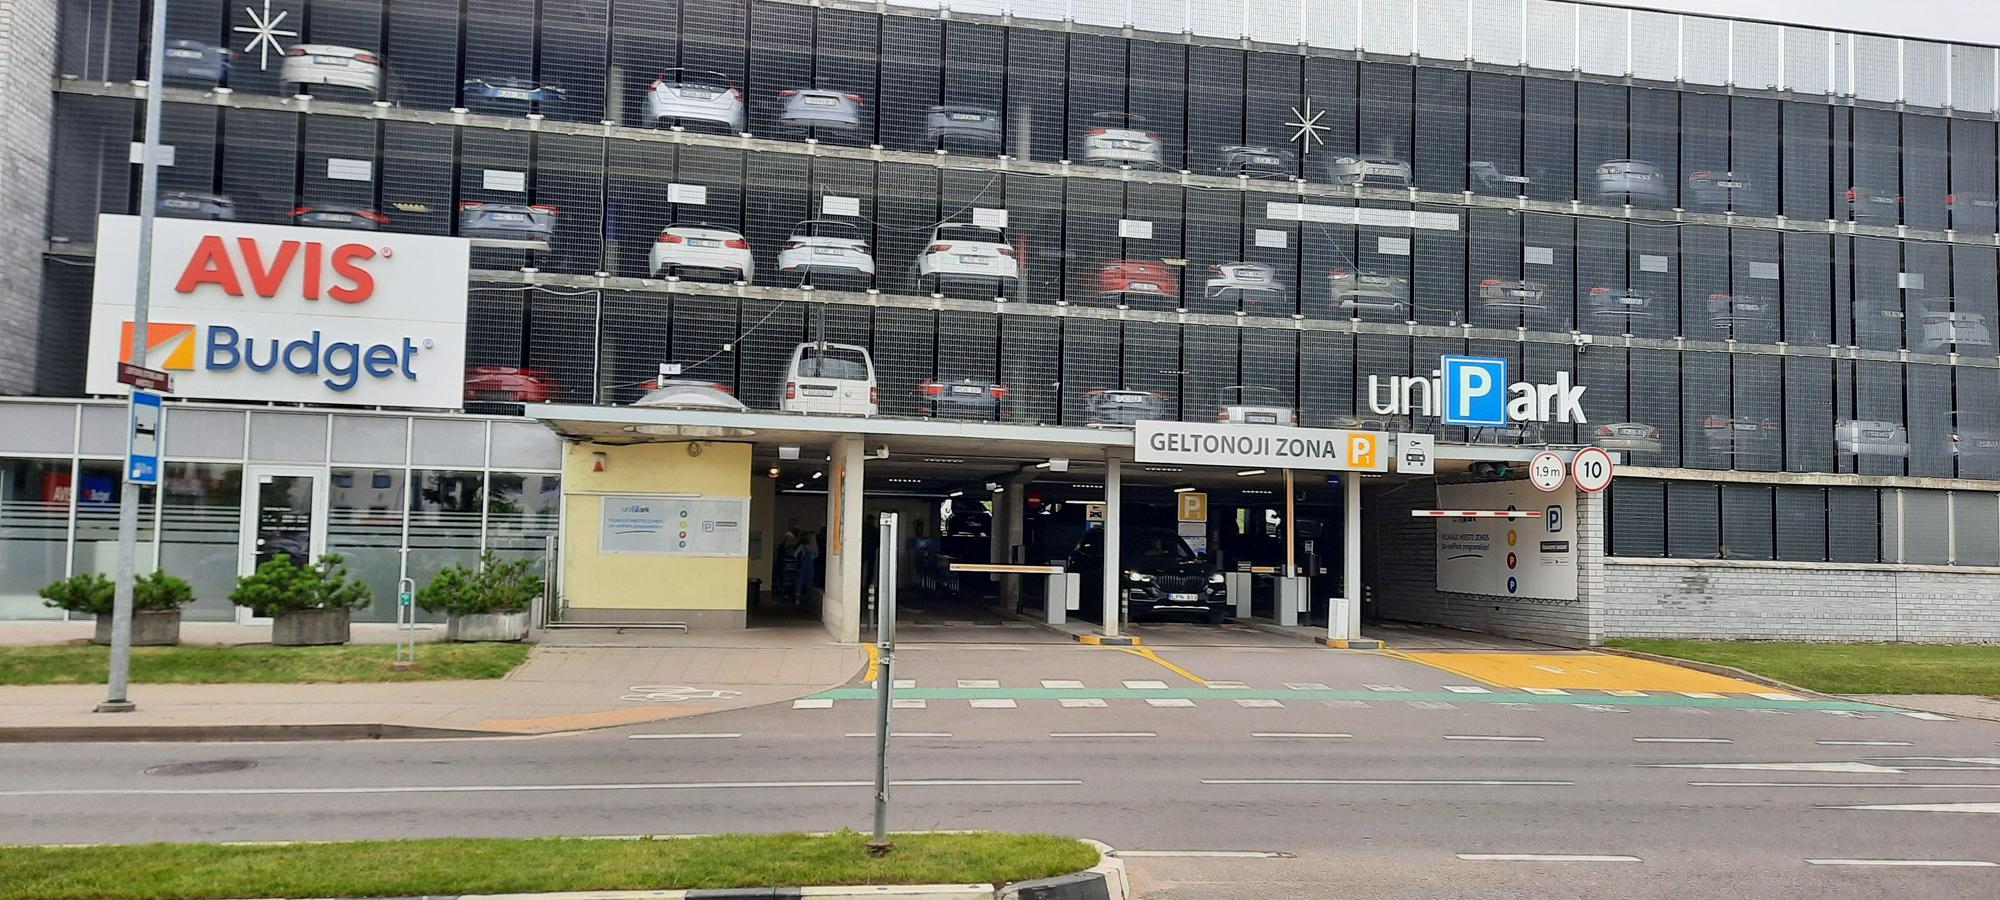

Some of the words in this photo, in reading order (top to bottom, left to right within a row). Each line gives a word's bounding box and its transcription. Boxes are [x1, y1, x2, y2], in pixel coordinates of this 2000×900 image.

[175, 235, 376, 304] AVIS
[206, 325, 418, 392] Budget
[1150, 432, 1270, 456] GELTONOJI
[1275, 438, 1336, 459] ZONA
[1535, 465, 1549, 477] 1.9
[1583, 461, 1602, 479] 10
